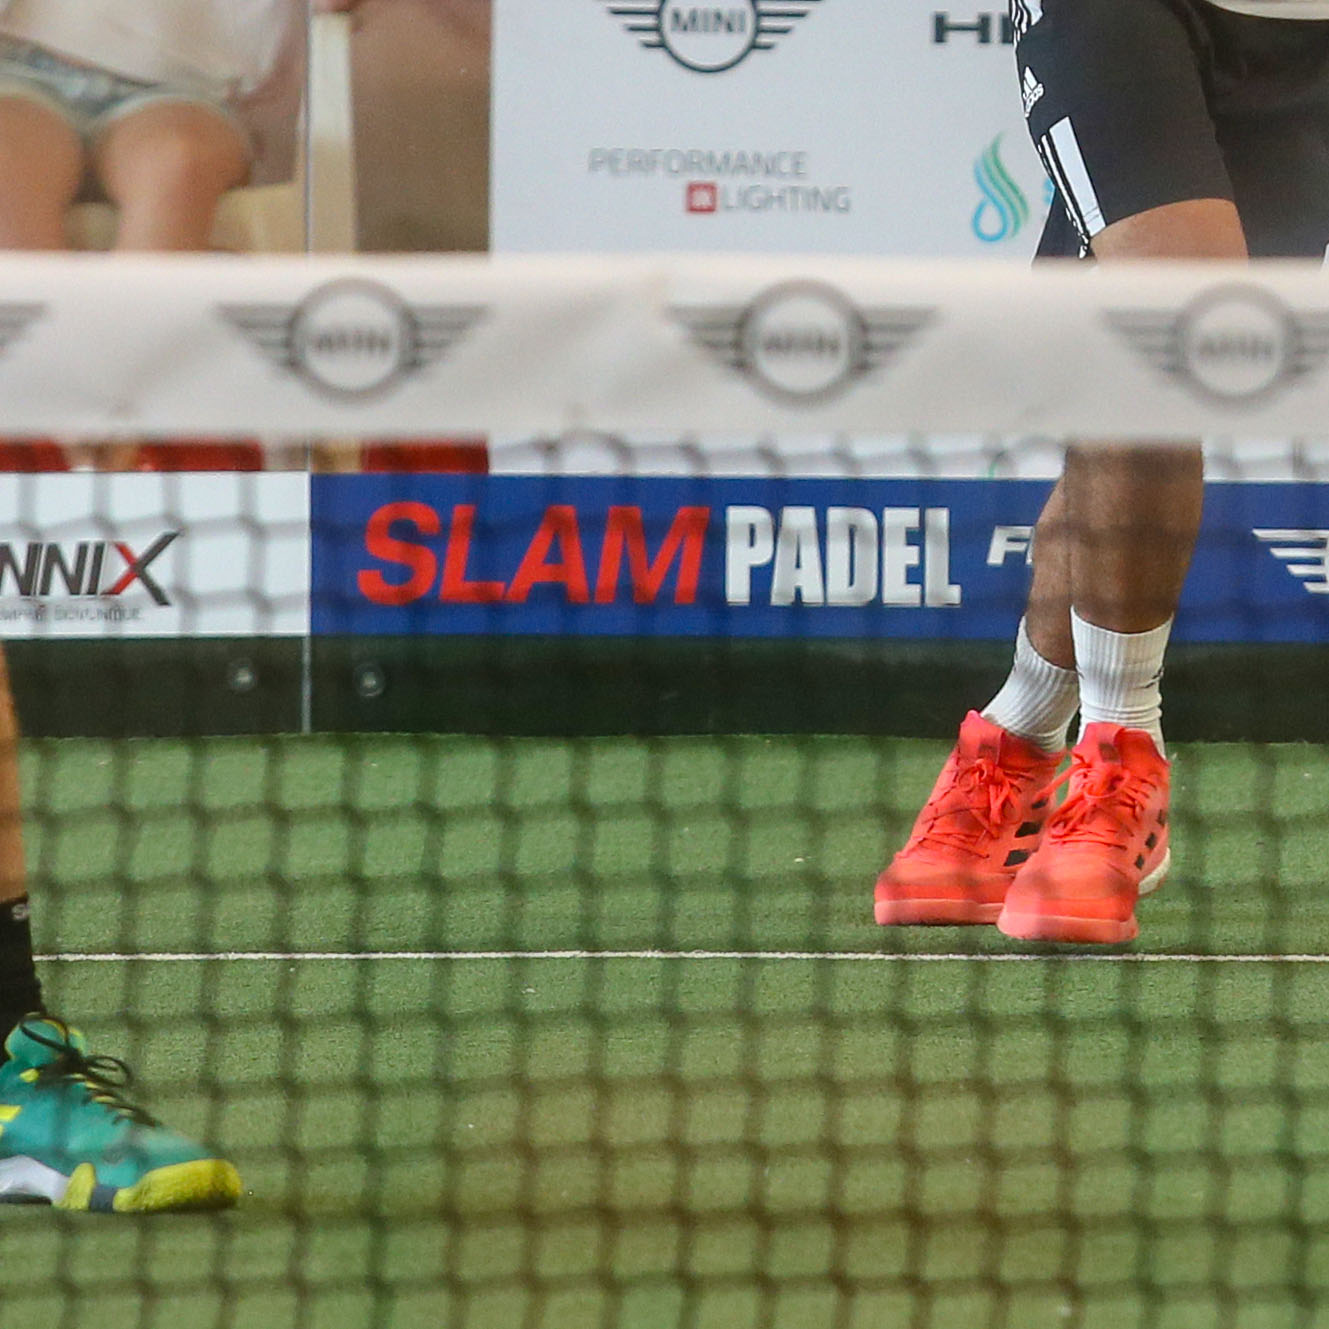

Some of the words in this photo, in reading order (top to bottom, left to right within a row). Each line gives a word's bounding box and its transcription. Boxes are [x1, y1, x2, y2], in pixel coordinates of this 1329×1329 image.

[672, 9, 747, 35] MINI
[589, 148, 807, 175] PERFORMANCE
[723, 186, 850, 214] LIGHTING
[356, 501, 711, 606] SLAM
[725, 504, 962, 608] PADEL
